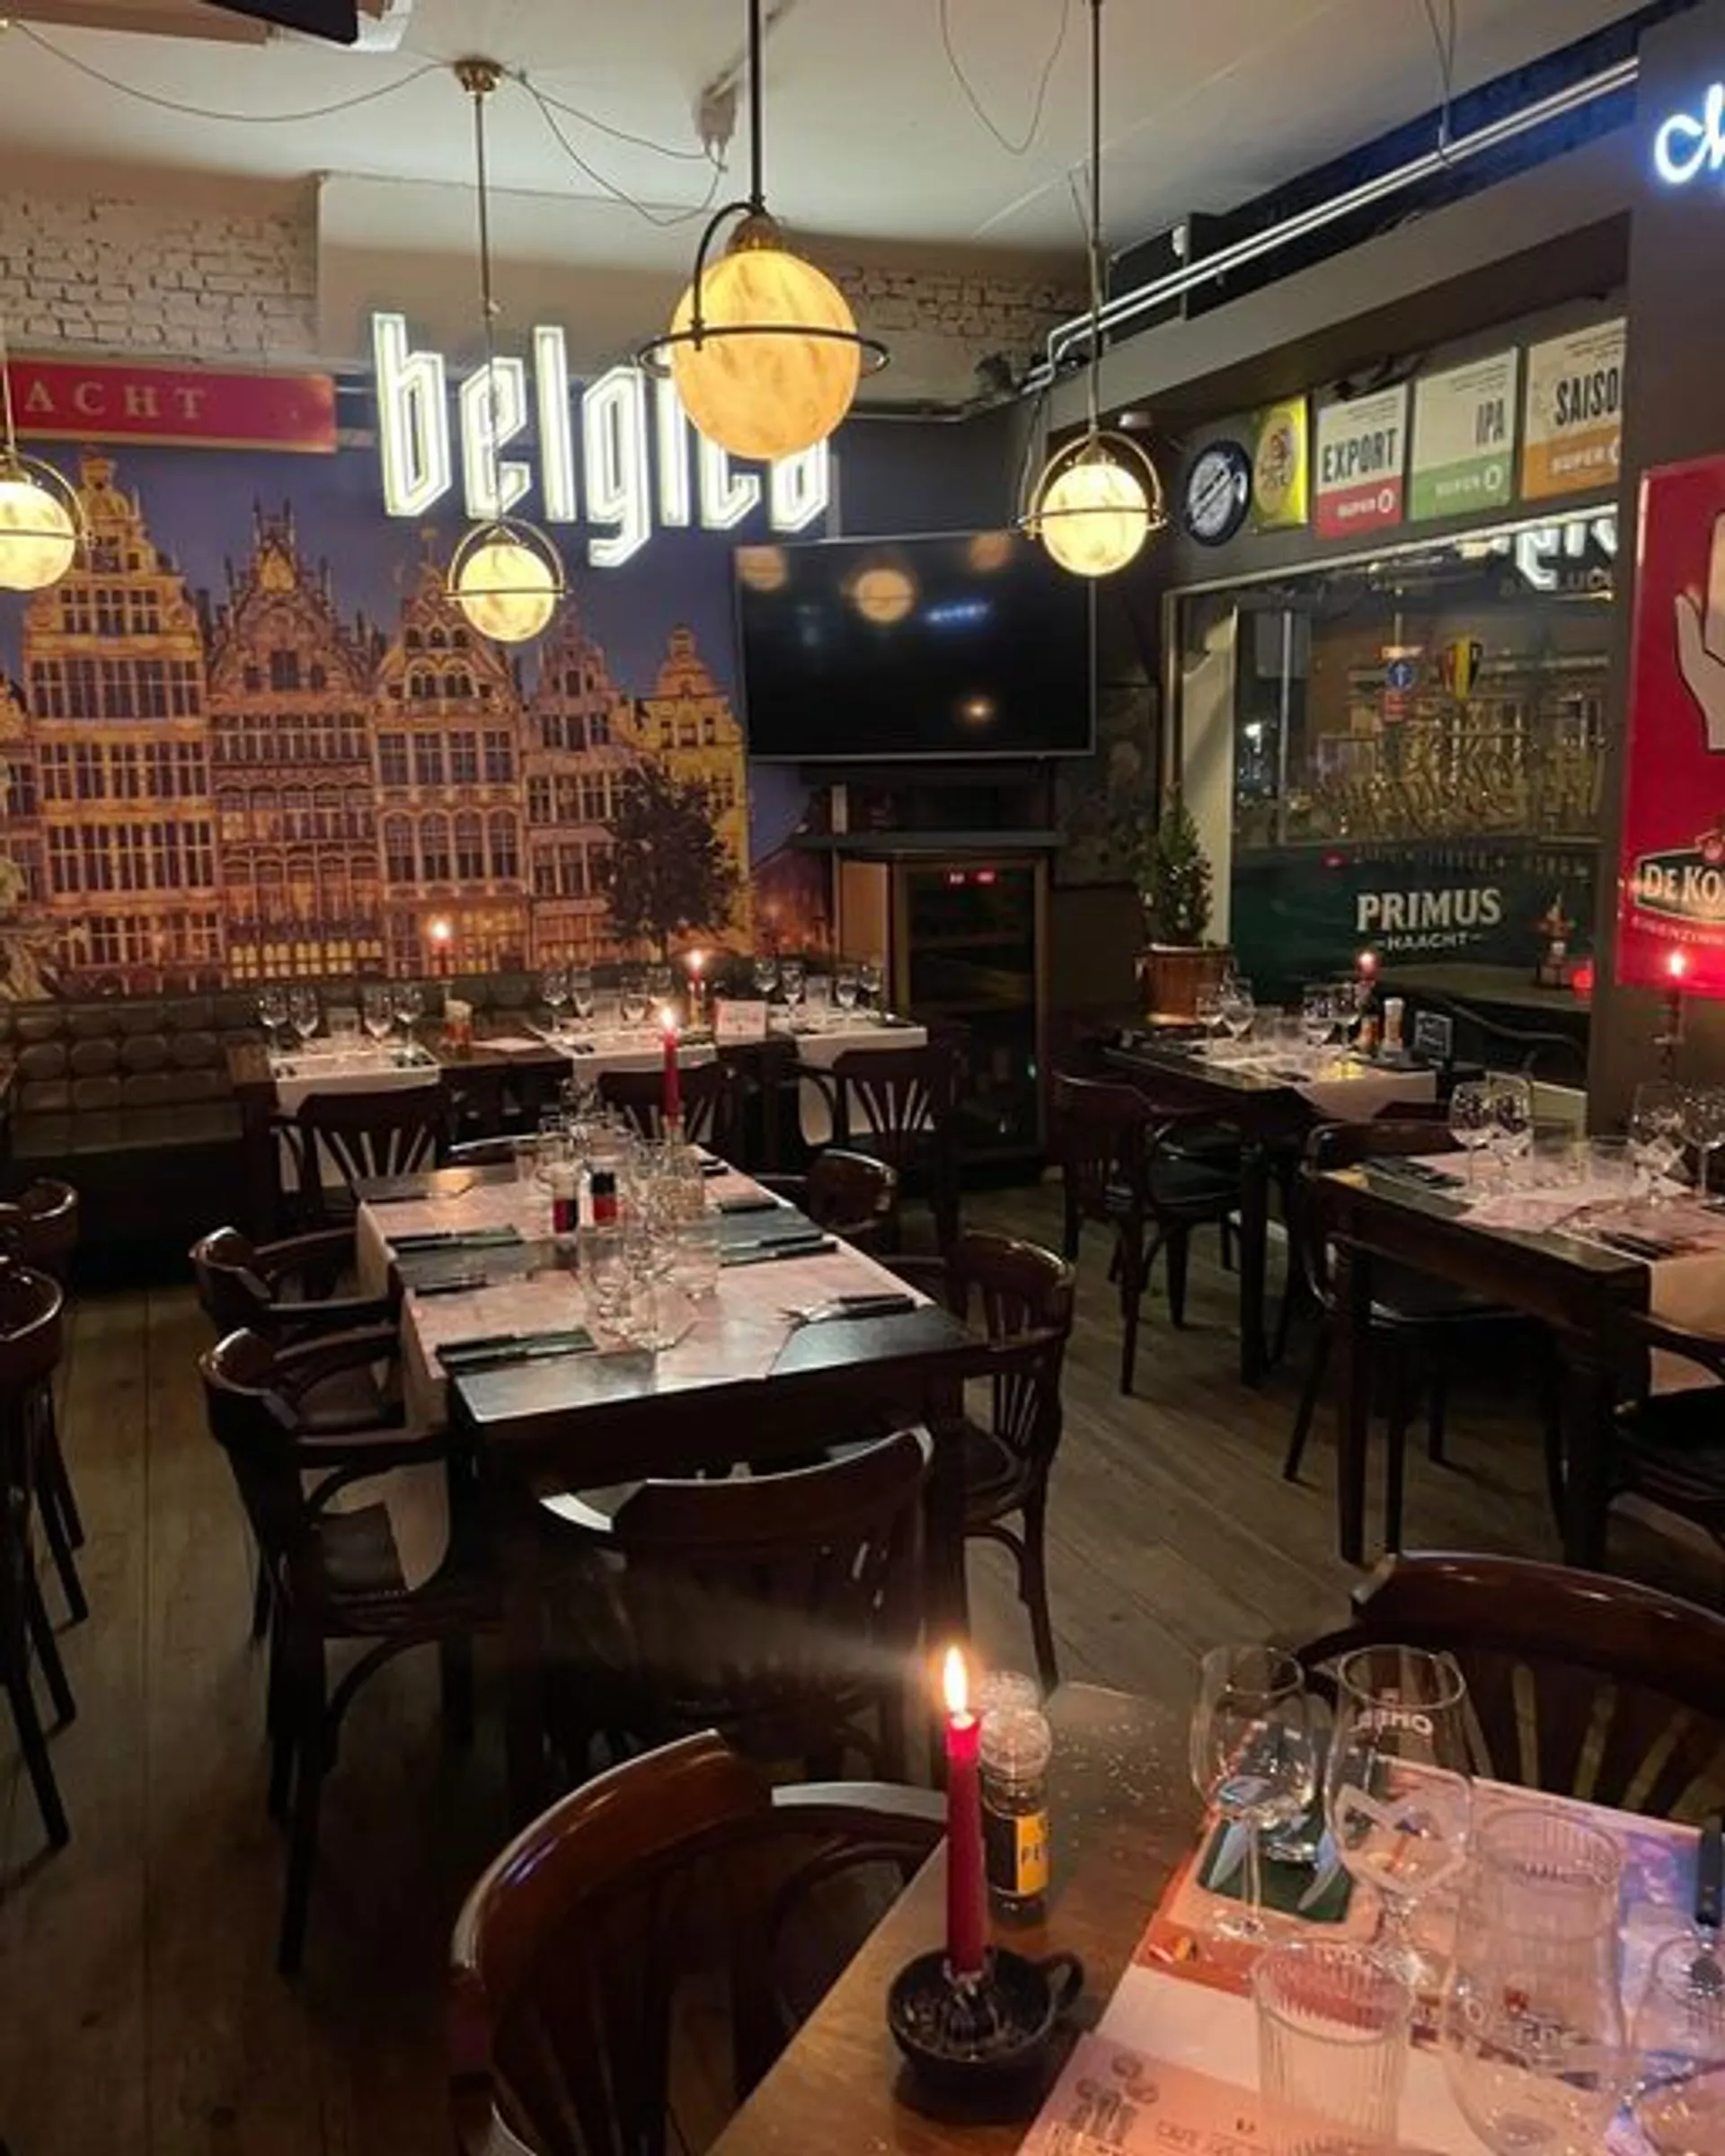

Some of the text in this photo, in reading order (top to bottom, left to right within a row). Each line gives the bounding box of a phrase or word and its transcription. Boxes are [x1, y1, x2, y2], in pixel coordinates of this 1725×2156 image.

[1475, 399, 1504, 445] IPA
[1322, 427, 1398, 483] EXPORT
[1357, 887, 1502, 932] PRIMUS
